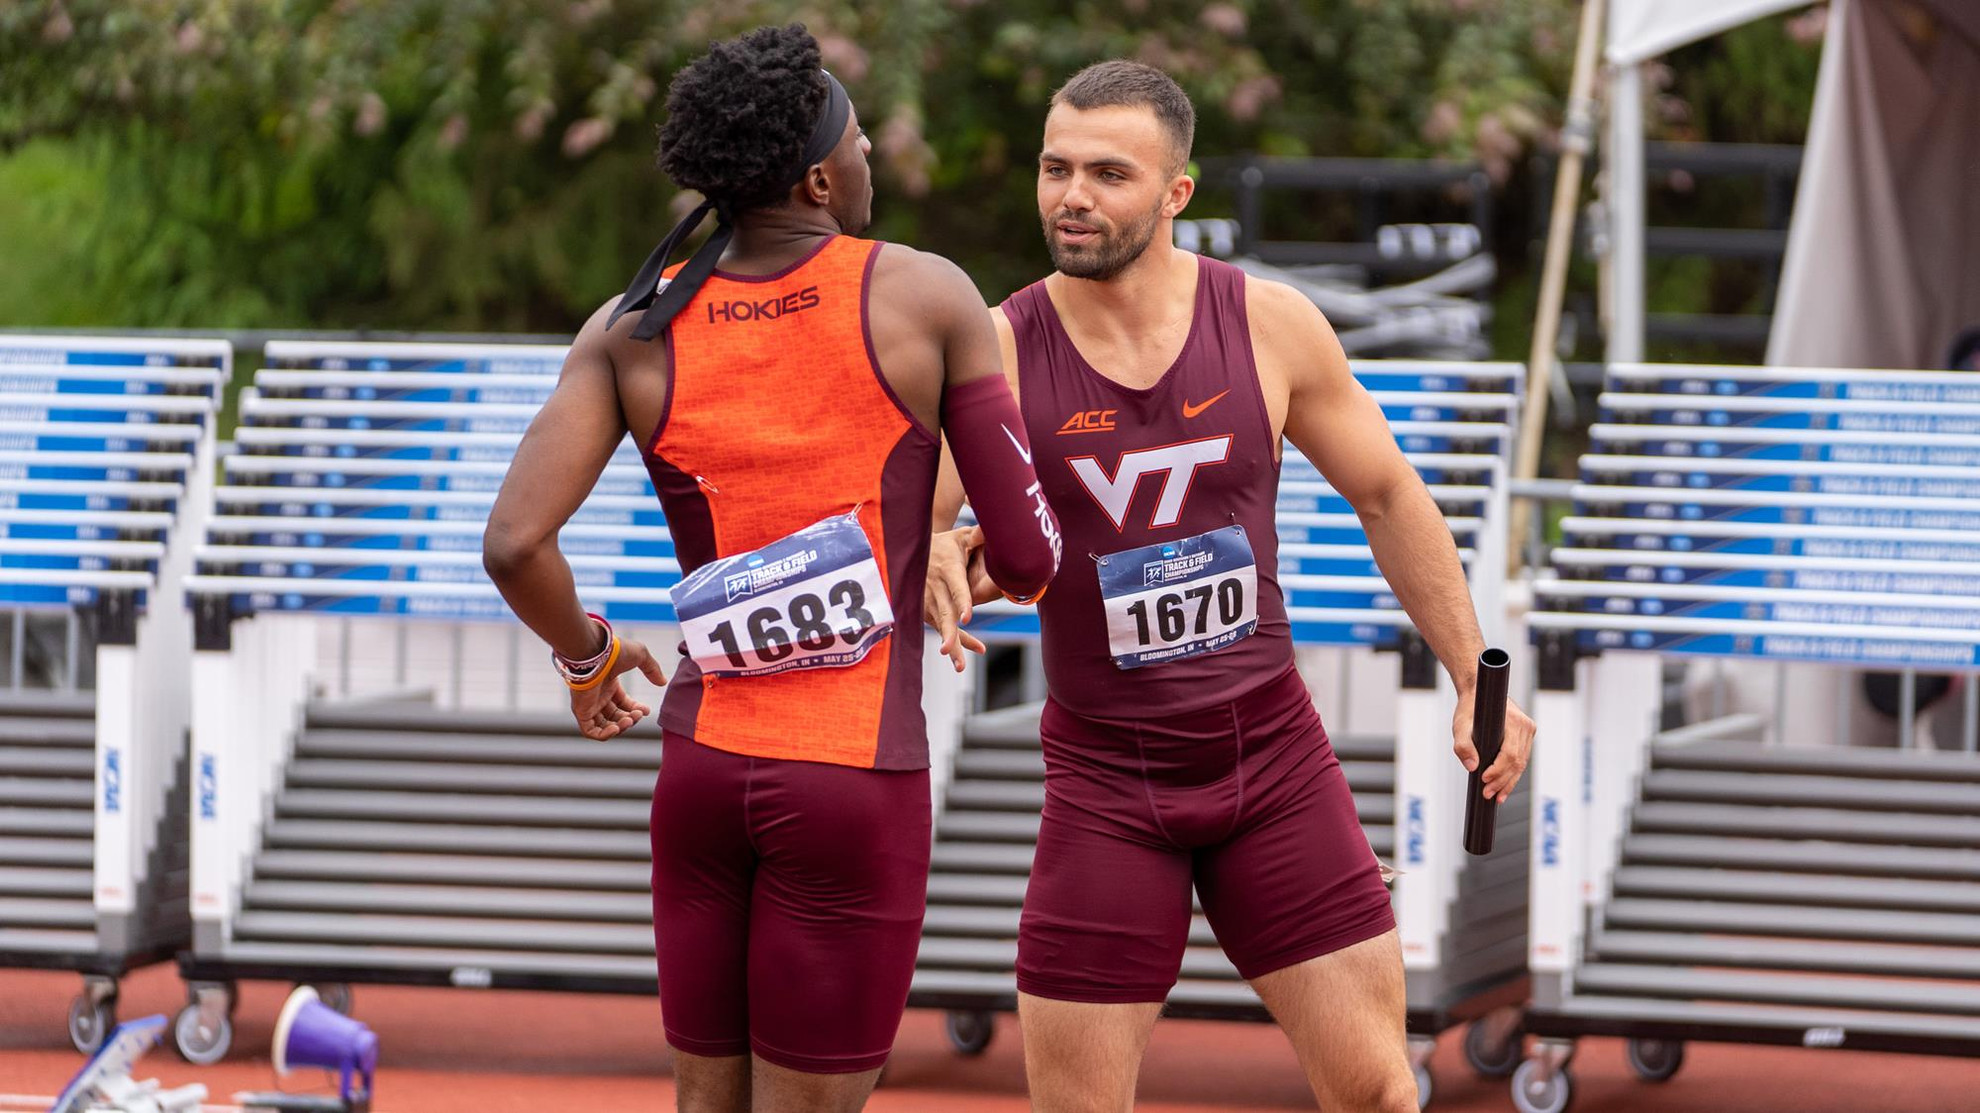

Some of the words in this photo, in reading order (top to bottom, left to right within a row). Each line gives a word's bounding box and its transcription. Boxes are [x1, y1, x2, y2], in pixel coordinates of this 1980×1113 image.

[708, 285, 820, 324] HOKIES
[1058, 410, 1118, 434] ACC
[1064, 434, 1235, 534] VT
[751, 564, 782, 580] TRACK
[791, 550, 818, 568] FIELD
[1164, 561, 1188, 572] TRACK
[1195, 553, 1213, 566] FIELD
[708, 579, 876, 668] 1683
[1127, 578, 1243, 646] 1670
[823, 655, 841, 663] MAY
[1187, 643, 1194, 652] IN
